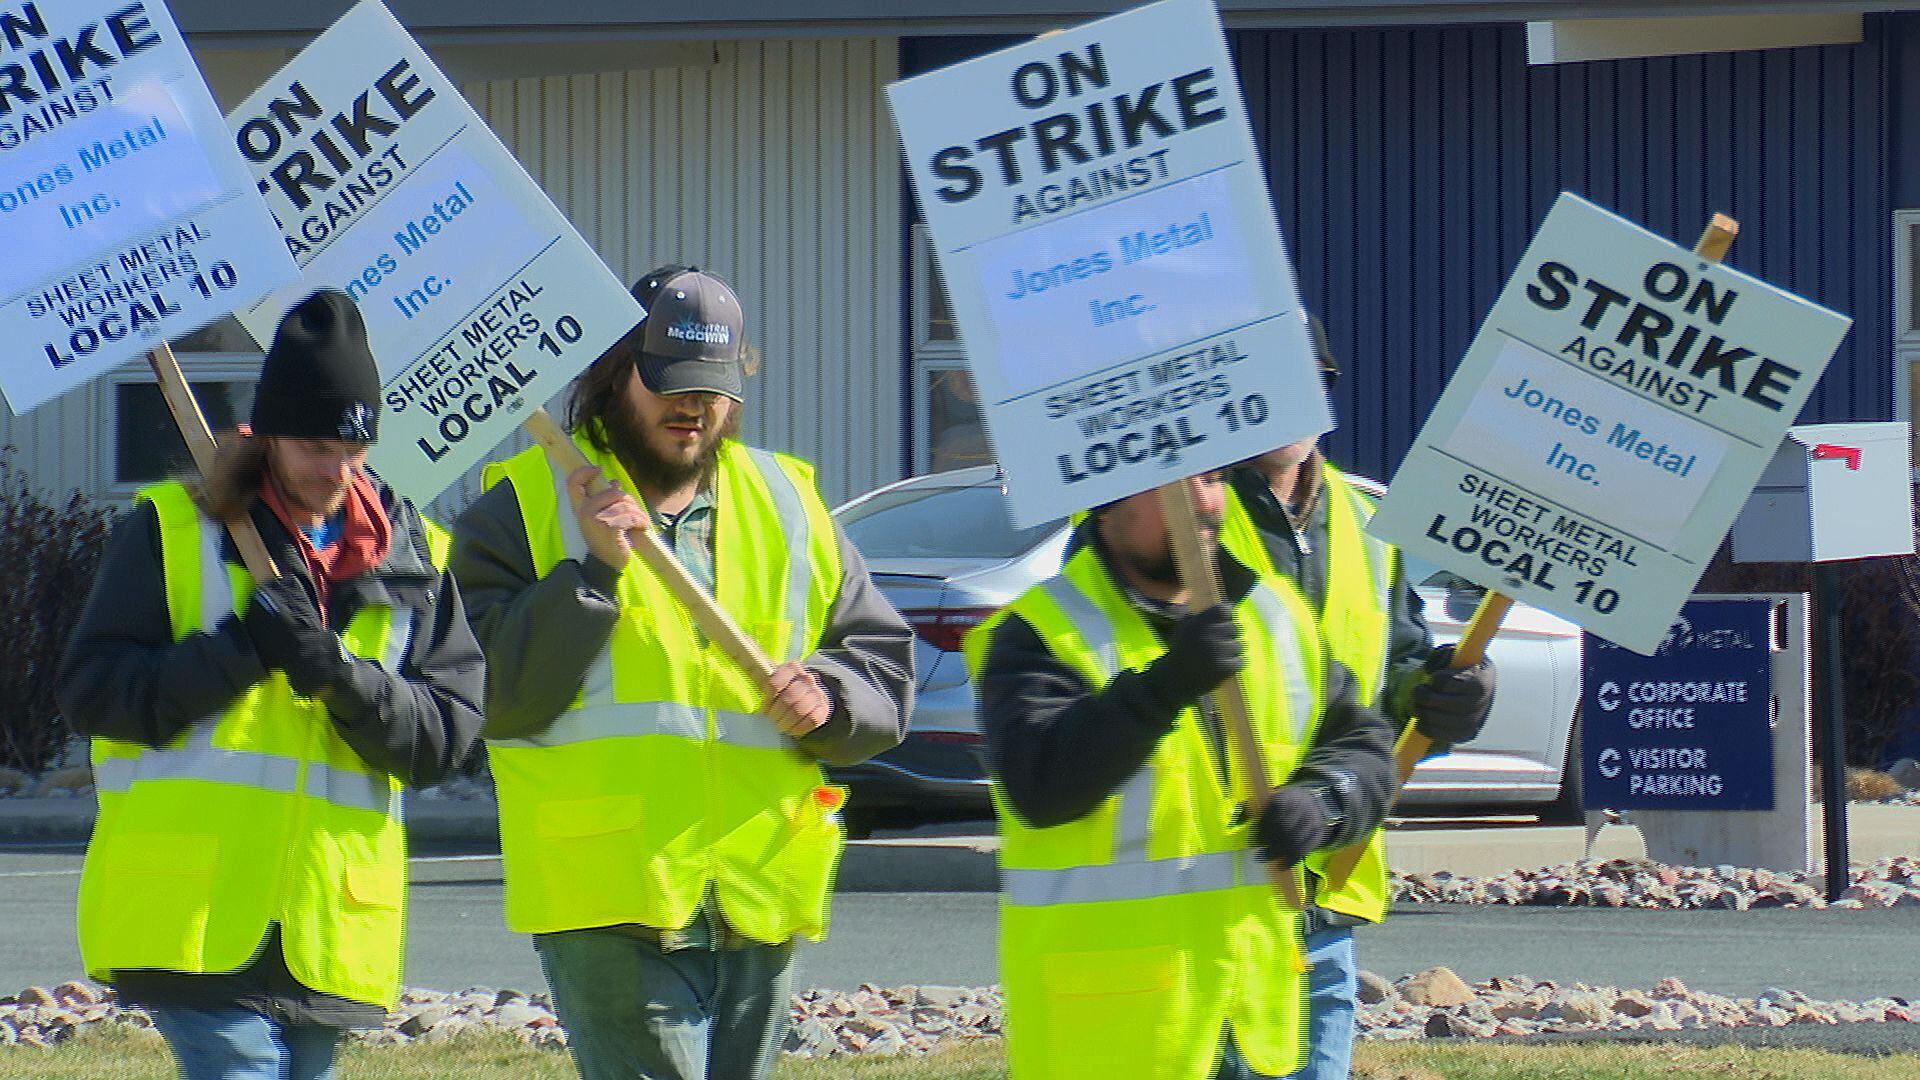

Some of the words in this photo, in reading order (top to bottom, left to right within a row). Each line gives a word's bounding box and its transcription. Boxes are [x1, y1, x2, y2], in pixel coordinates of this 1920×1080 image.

[0, 2, 48, 51] N
[0, 2, 162, 117] RIKE
[0, 75, 113, 149] GAINST
[1010, 43, 1110, 109] ON
[237, 80, 323, 163] ON
[257, 57, 436, 230] RIKE
[929, 67, 1228, 203] STRIKE
[0, 163, 74, 212] ones
[77, 115, 167, 173] Metal
[285, 142, 406, 260] AGAINST
[1012, 149, 1169, 224] AGAINST
[59, 193, 120, 229] Inc.
[345, 253, 397, 302] nes
[393, 181, 475, 256] Metal
[27, 263, 111, 318] SHEET
[118, 222, 211, 274] METAL
[58, 249, 199, 328] WORKERS
[1005, 250, 1112, 300] Jones
[1118, 211, 1214, 265] Metal
[1644, 262, 1738, 326] ON
[44, 292, 182, 370] LOCAL
[188, 259, 238, 300] 10
[393, 275, 452, 319] Inc.
[1089, 294, 1157, 327] Inc.
[1526, 262, 1802, 413] STRIKE
[386, 340, 462, 413] SHEET
[462, 280, 544, 349] METAL
[420, 313, 540, 417] WORKERS
[1045, 370, 1141, 419] SHEET
[1148, 340, 1248, 387] METAL
[1561, 336, 1718, 413] AGAINST
[416, 361, 538, 463] LOCAL
[538, 315, 583, 358] 10
[1076, 374, 1232, 438] WORKERS
[1504, 378, 1600, 435] Jones
[1607, 422, 1697, 478] Metal
[1056, 416, 1207, 484] LOCAL
[1216, 393, 1269, 433] 10
[1546, 442, 1600, 487] Inc.
[1458, 473, 1551, 524] SHEET
[1551, 515, 1638, 567] METAL
[1471, 504, 1606, 576] WORKERS
[1425, 514, 1556, 591] LOCAL
[1574, 579, 1620, 614] 10
[1628, 681, 1748, 702] CORPORATE
[1628, 708, 1695, 729] OFFICE
[1628, 748, 1707, 769] VISITOR
[1630, 775, 1723, 795] PARKING
